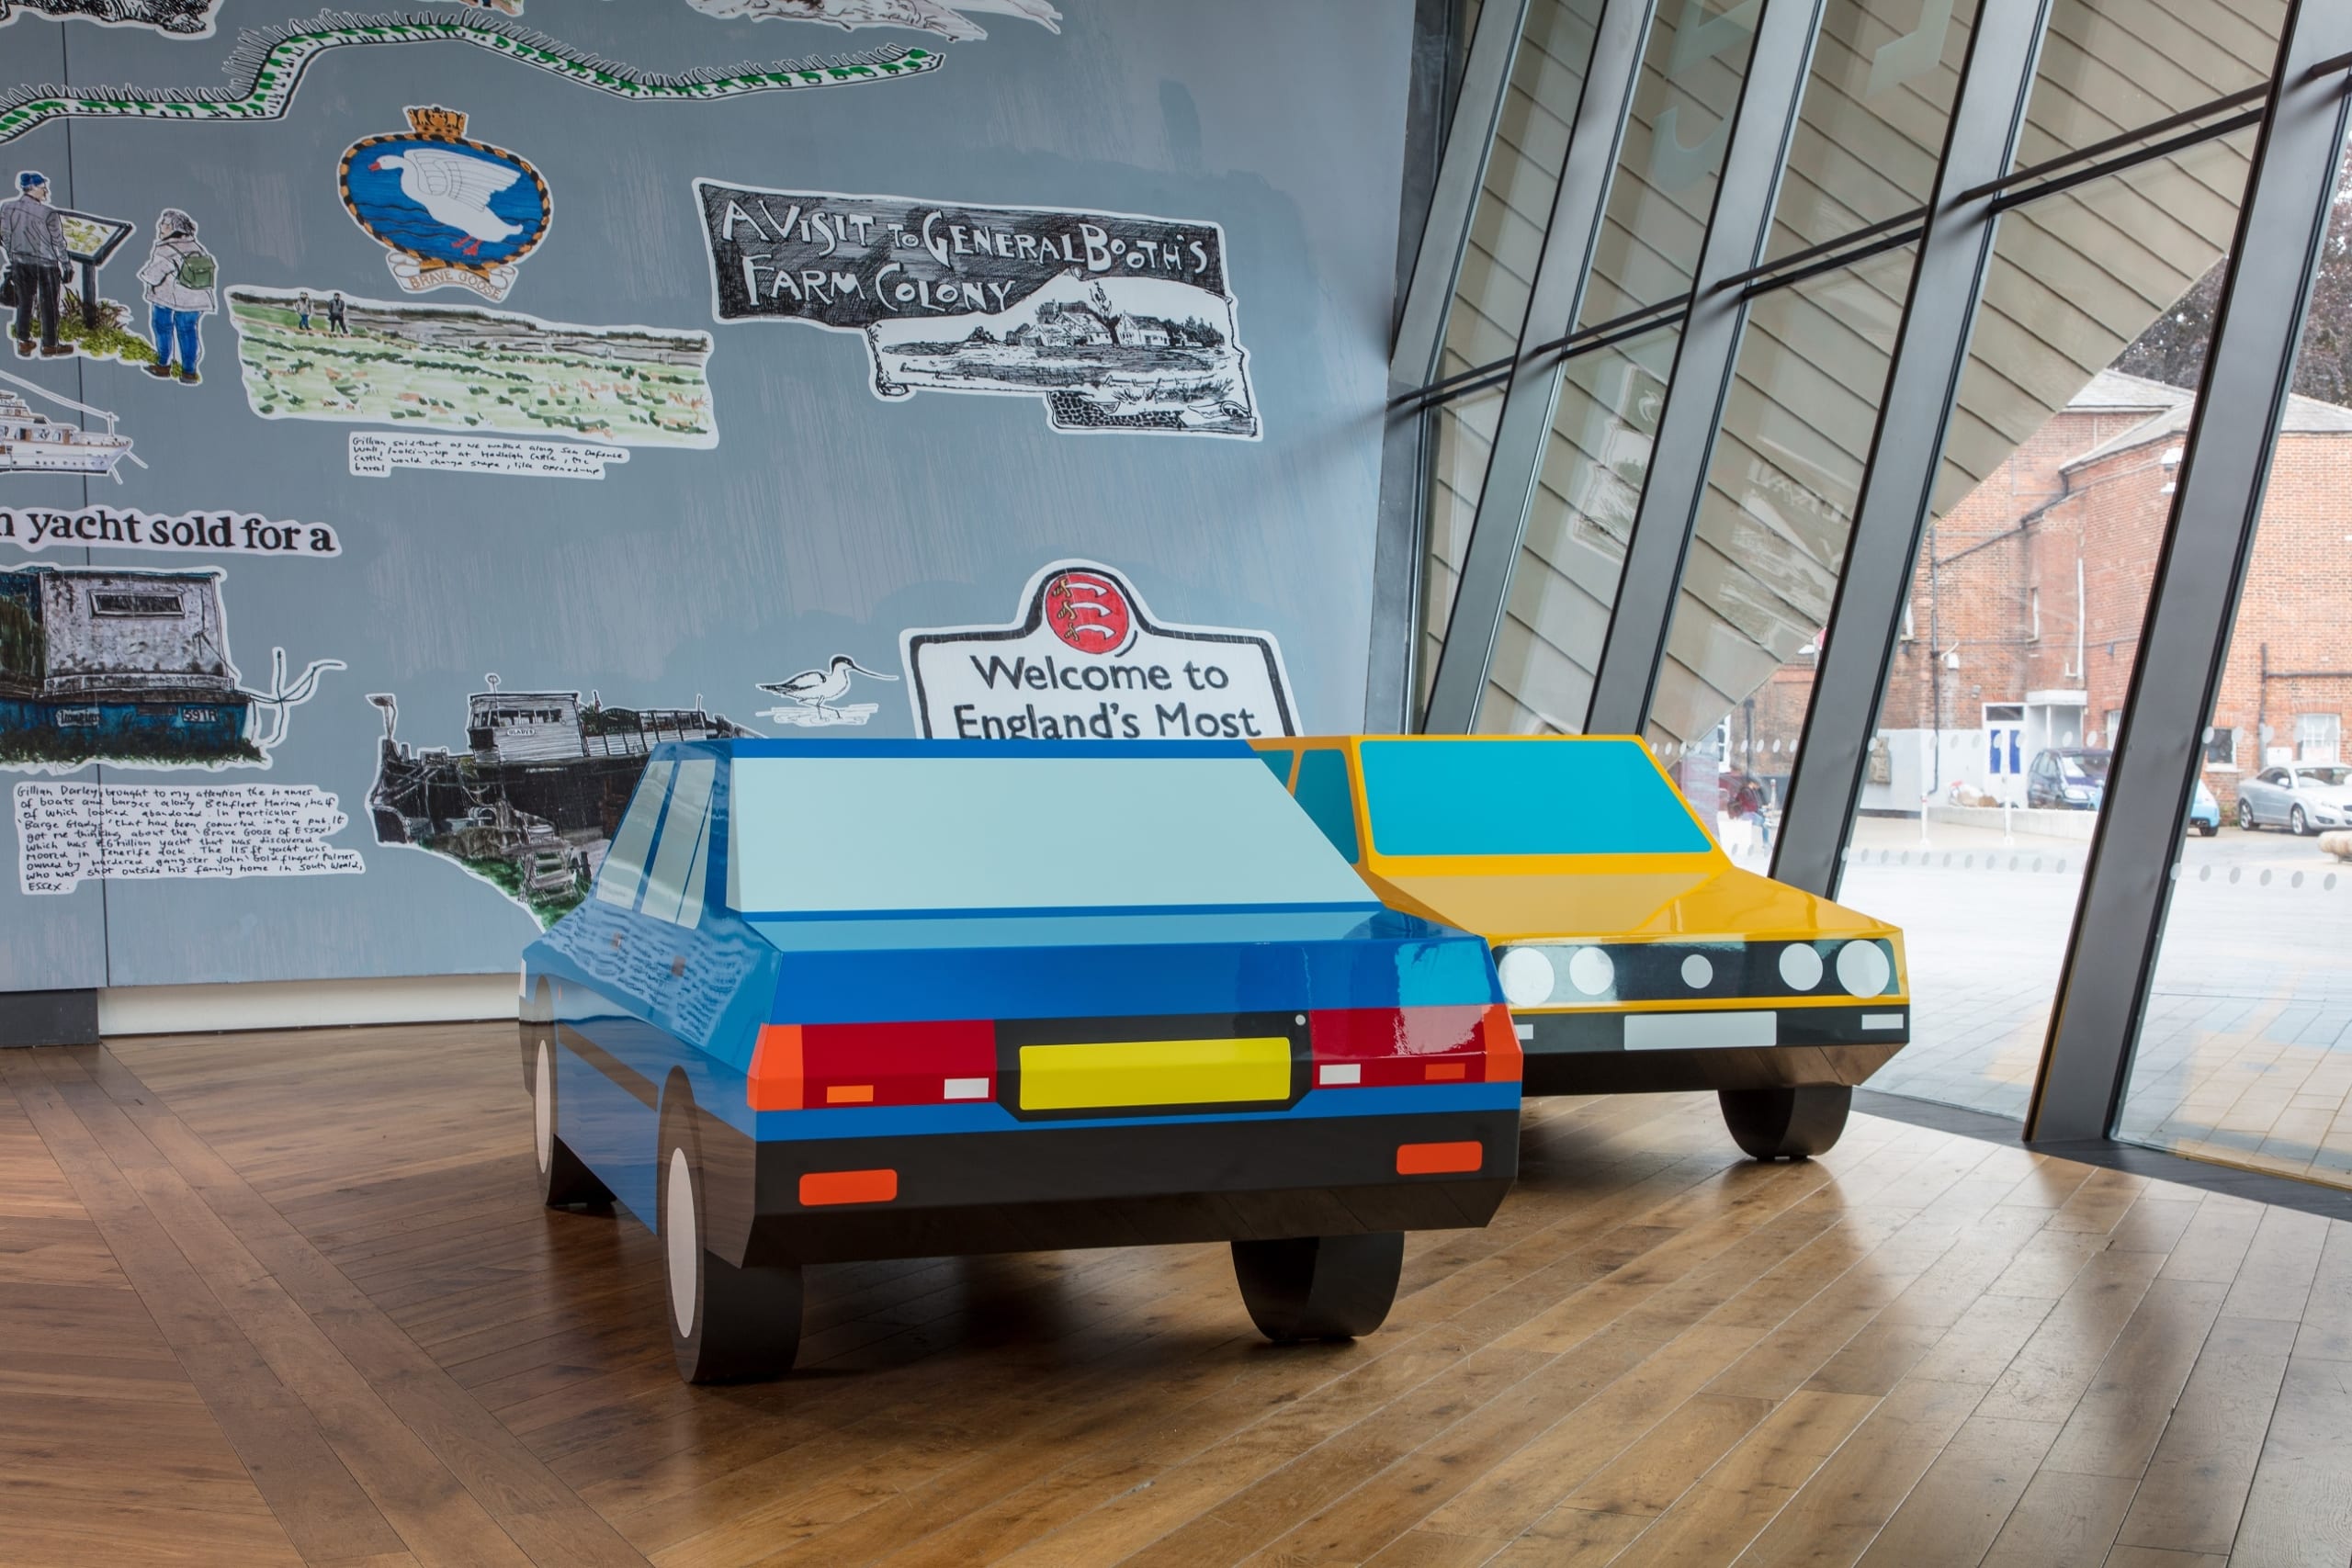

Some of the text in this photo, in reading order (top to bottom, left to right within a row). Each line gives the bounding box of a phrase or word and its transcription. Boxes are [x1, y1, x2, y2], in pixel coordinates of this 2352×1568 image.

[722, 200, 752, 242] A
[755, 202, 876, 258] VISIT
[922, 211, 1075, 269] GENERAL
[1079, 223, 1207, 274] BOOTH'S
[409, 270, 502, 299] BRAVE GOOSE
[742, 254, 1015, 311] FARM COLONY
[27, 510, 141, 544] yacht
[150, 515, 234, 548] sold
[241, 517, 300, 549] for
[311, 528, 335, 551] a
[969, 655, 1229, 691] Welcome to
[954, 702, 1261, 739] England's Most
